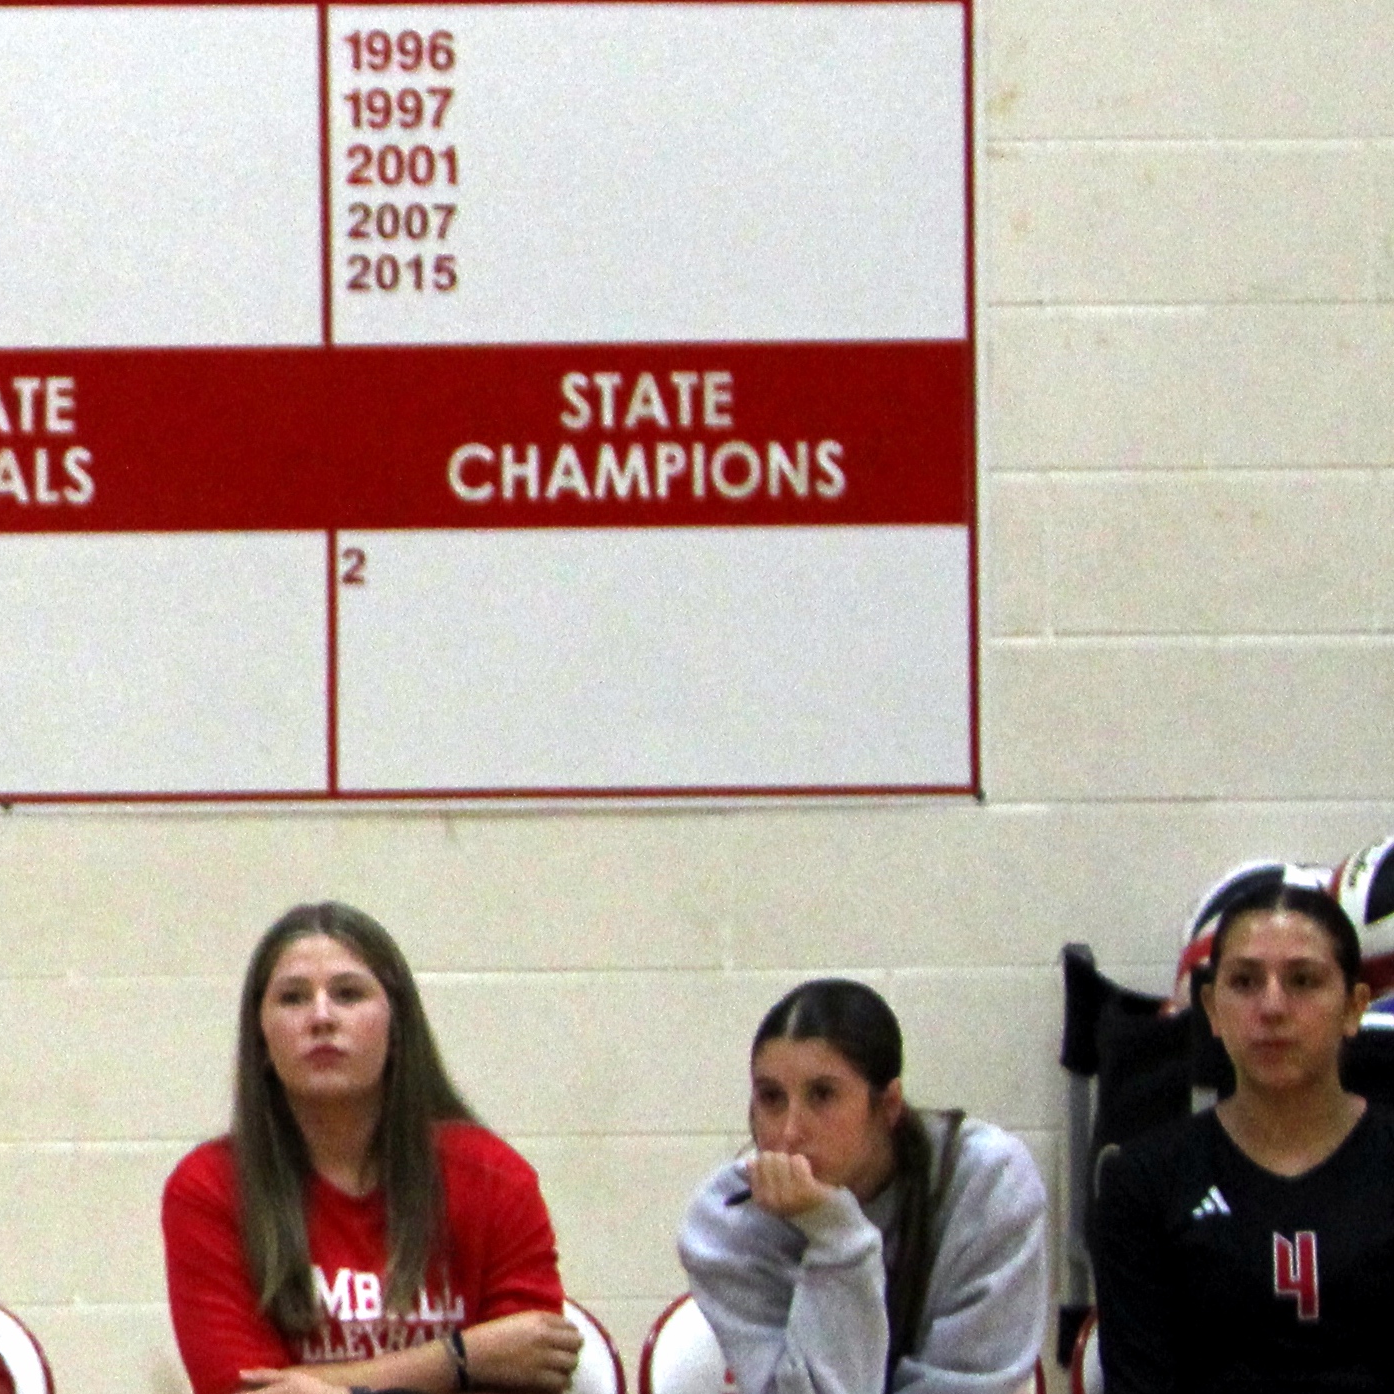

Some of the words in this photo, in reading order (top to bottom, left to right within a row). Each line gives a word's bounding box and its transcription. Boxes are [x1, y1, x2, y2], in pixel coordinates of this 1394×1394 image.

[345, 30, 455, 72] 1996
[345, 87, 453, 130] 1997
[347, 144, 458, 187] 2001
[347, 202, 456, 241] 2007
[347, 254, 457, 292] 2015
[561, 371, 732, 429] STATE
[448, 440, 845, 501] CHAMPIONS
[341, 548, 366, 585] 2
[1272, 1230, 1319, 1320] 4
